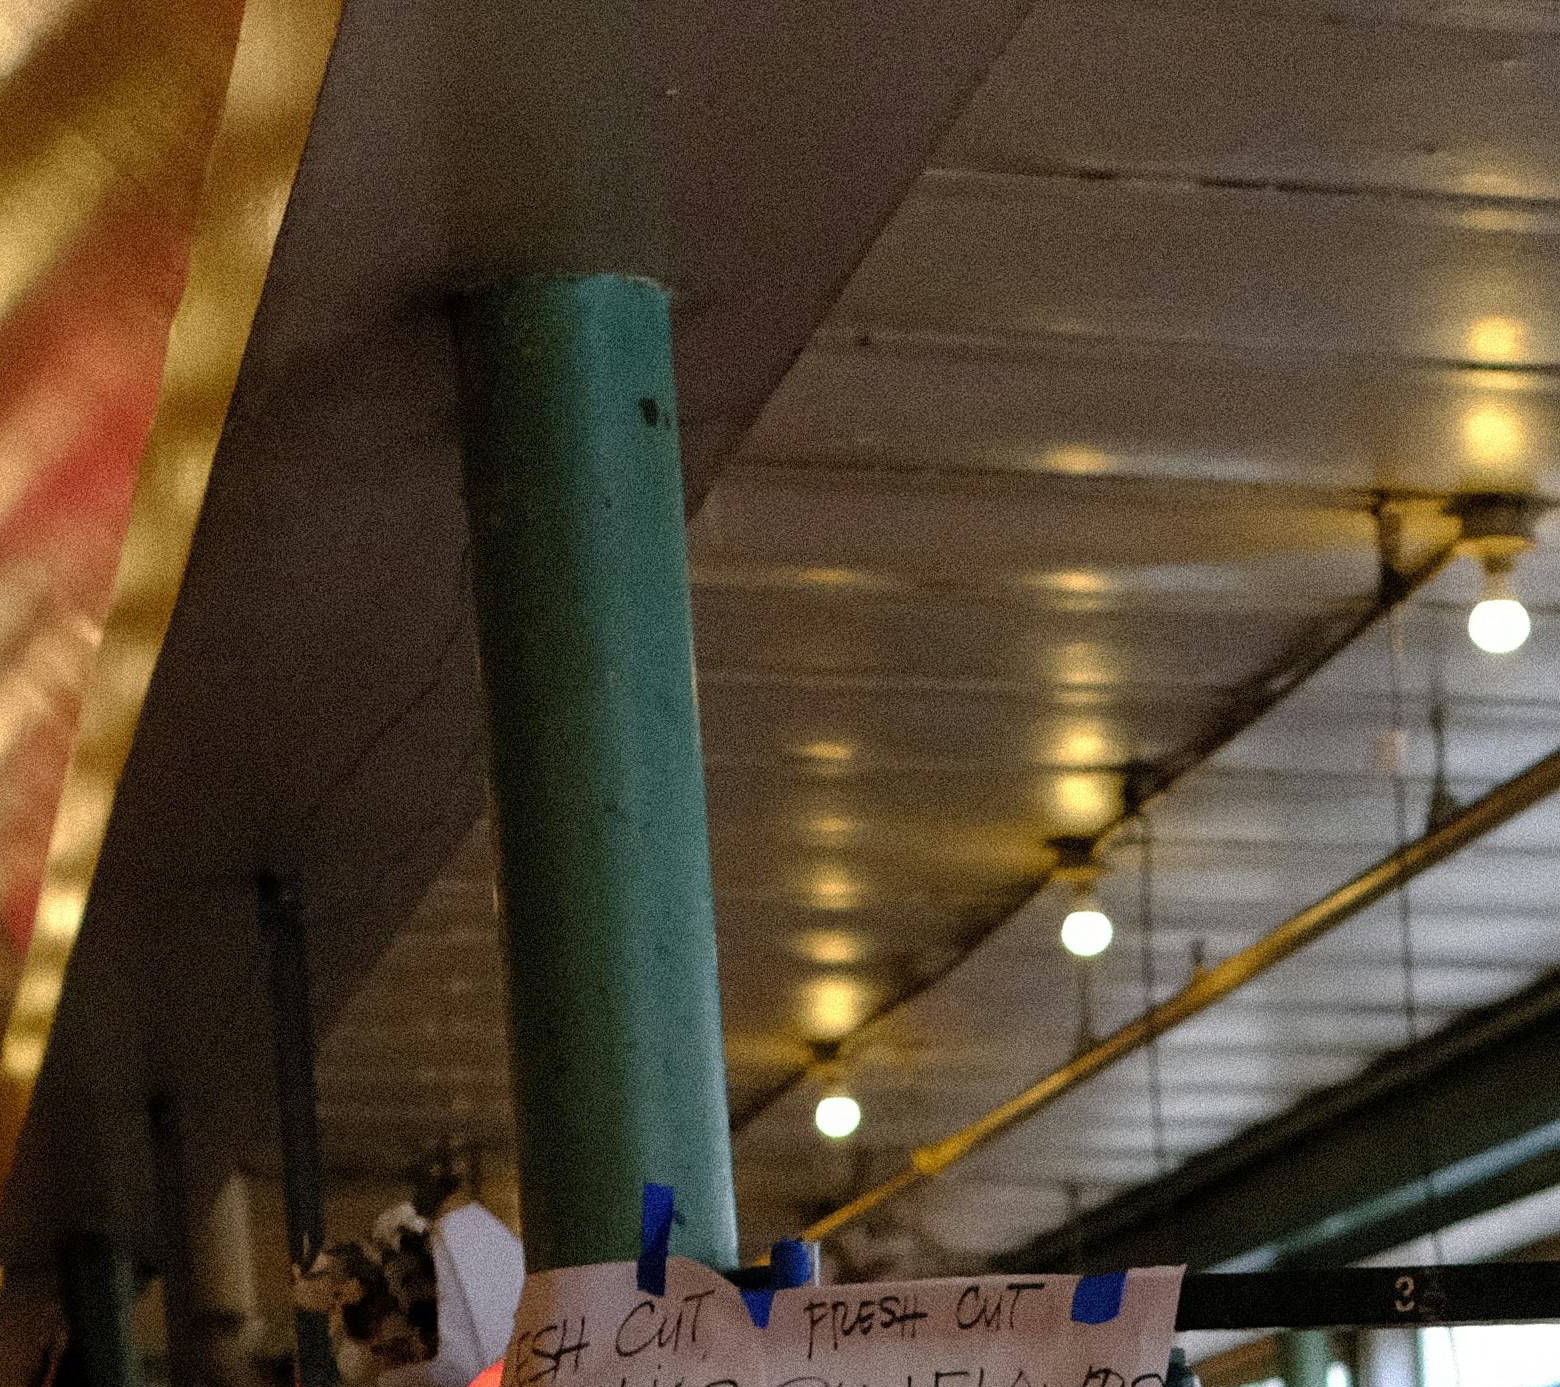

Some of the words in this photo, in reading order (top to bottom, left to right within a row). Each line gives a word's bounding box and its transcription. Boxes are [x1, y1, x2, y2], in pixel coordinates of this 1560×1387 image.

[615, 1289, 715, 1357] CUT
[803, 1296, 928, 1359] FRESH
[956, 1283, 1046, 1331] CUT
